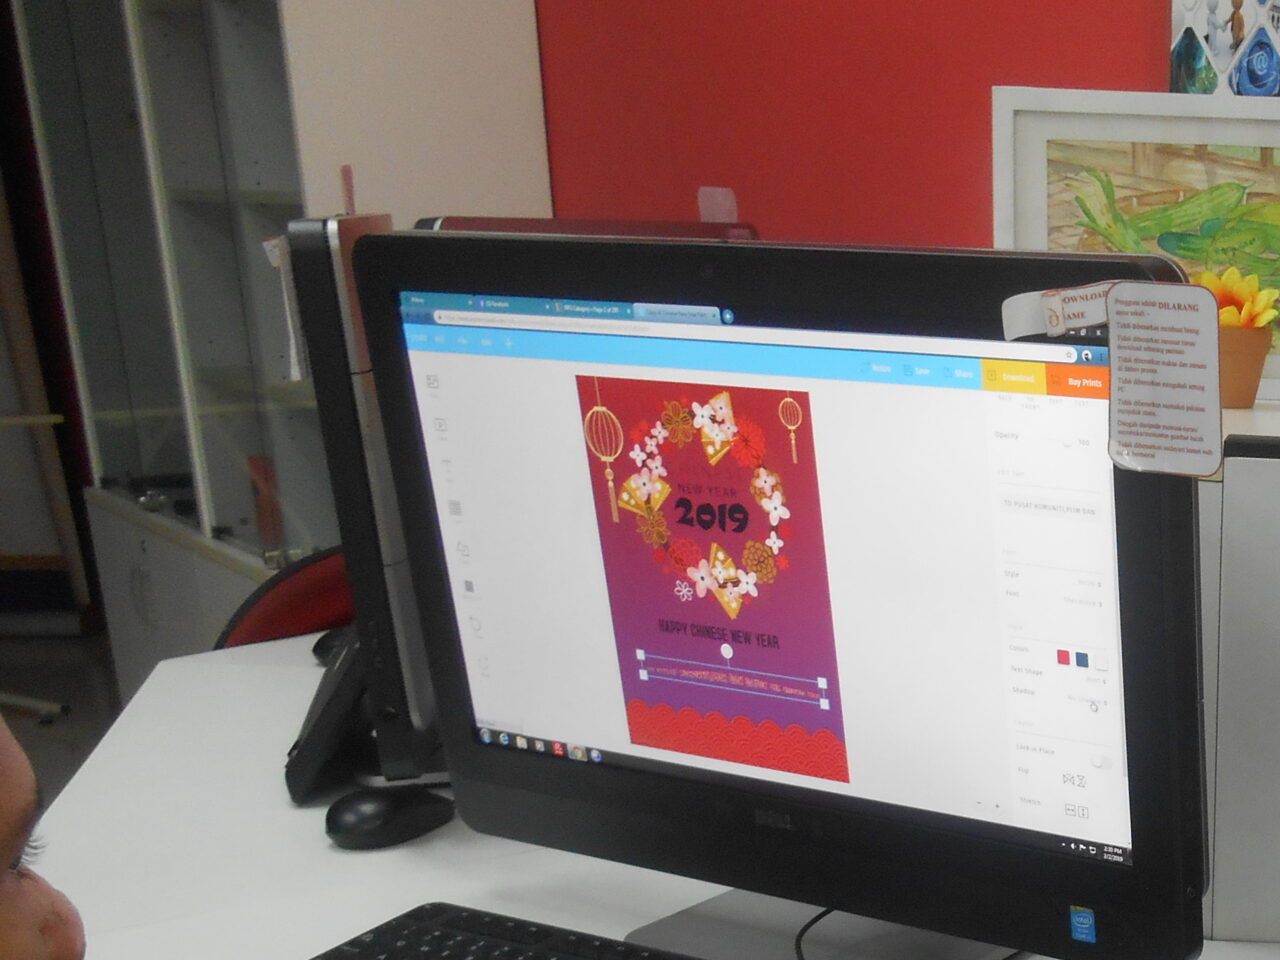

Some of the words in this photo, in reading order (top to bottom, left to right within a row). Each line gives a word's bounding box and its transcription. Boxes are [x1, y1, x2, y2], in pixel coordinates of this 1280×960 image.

[1062, 290, 1108, 304] OWNLOAD
[1158, 302, 1199, 312] DILARANG
[1064, 311, 1086, 320] AME
[1068, 377, 1082, 388] Buy
[1082, 378, 1103, 388] Prints
[995, 431, 1019, 441] Opacity
[1078, 439, 1090, 447] 100
[677, 483, 703, 495] NEW
[707, 485, 738, 498] YEAR
[674, 496, 750, 533] 2019
[658, 618, 688, 635] HAPPY
[689, 622, 729, 642] CHINESE
[729, 628, 752, 645] NEW
[755, 632, 780, 649] YEAR
